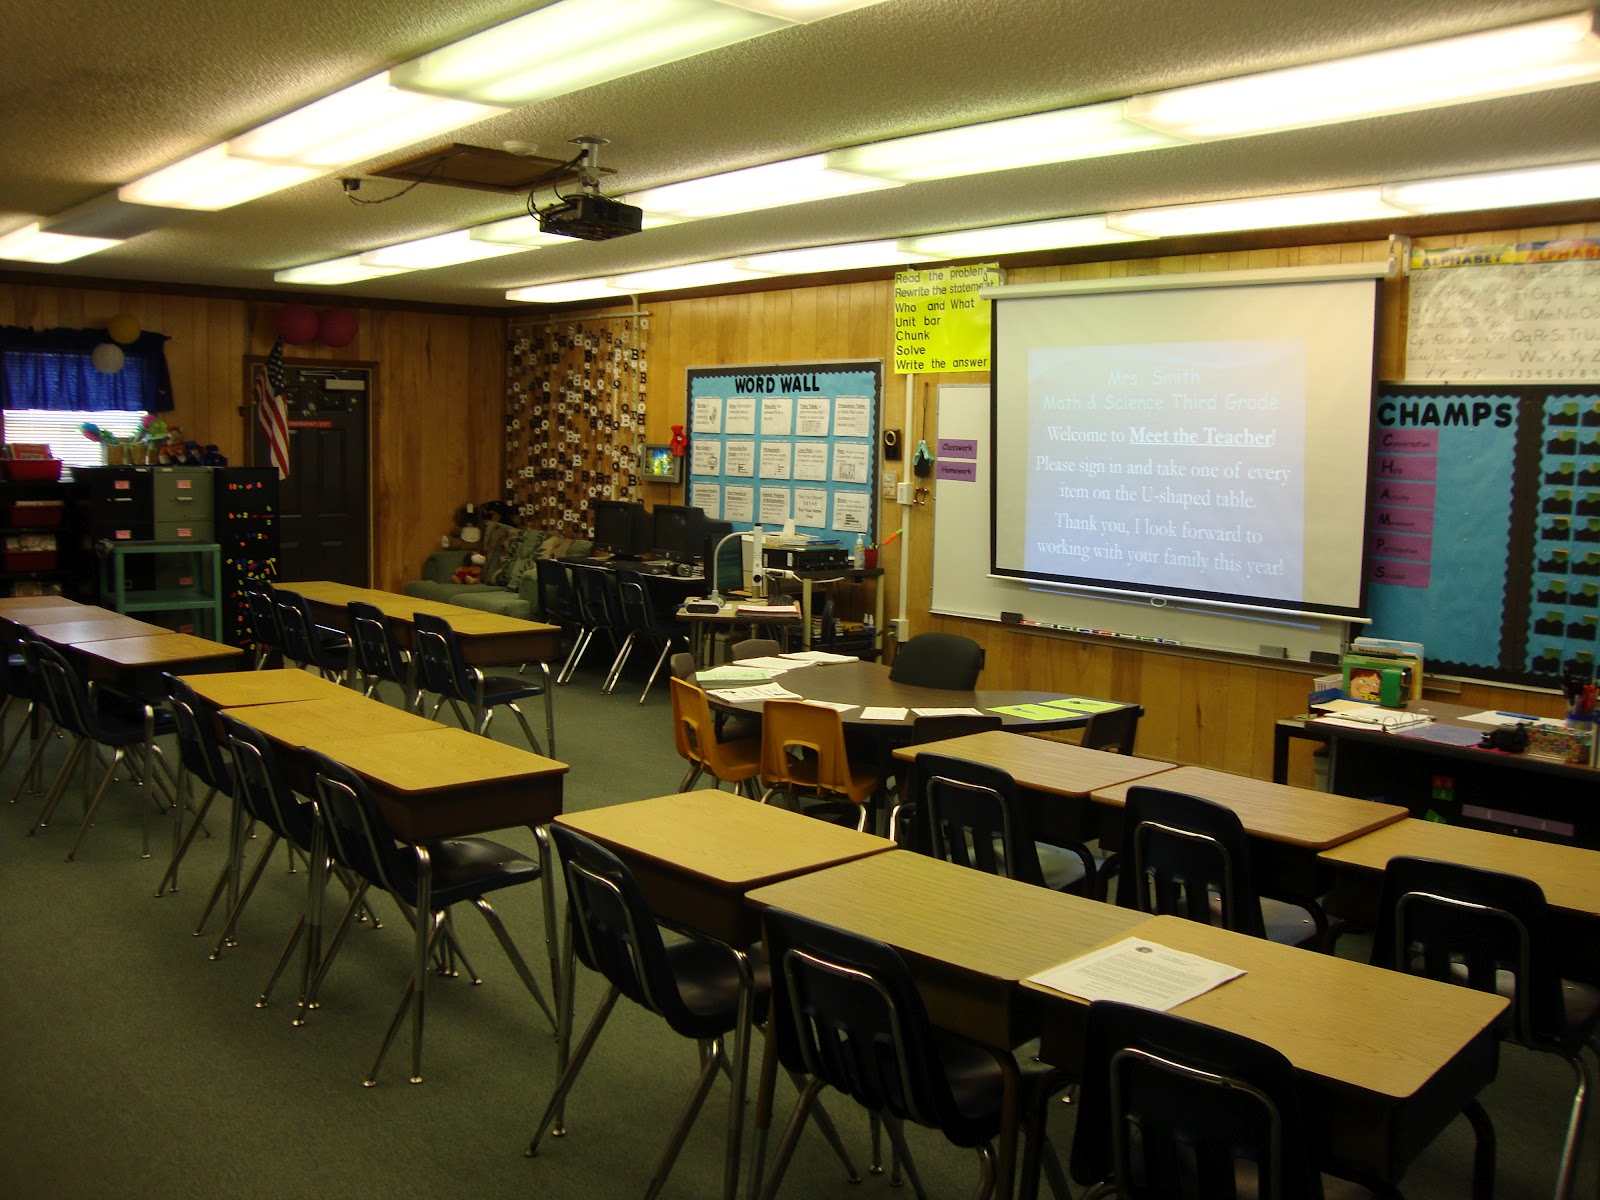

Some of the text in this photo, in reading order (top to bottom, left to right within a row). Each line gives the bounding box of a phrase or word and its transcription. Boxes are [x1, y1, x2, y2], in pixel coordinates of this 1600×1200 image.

[1421, 253, 1502, 267] ALPHABET
[895, 273, 921, 284] Read
[928, 271, 944, 281] the
[895, 286, 930, 298] Rewrite
[932, 285, 947, 296] the
[895, 298, 975, 313] Who and What
[895, 316, 941, 327] Unit bar
[895, 330, 931, 341] Chunk
[895, 345, 926, 356] Solve
[896, 358, 988, 370] Write the answer
[735, 375, 820, 394] WORD WALL
[1151, 368, 1201, 386] Smith
[1043, 392, 1280, 411] Math & Science Third Grade
[1376, 401, 1514, 428] CHAMPS
[1047, 426, 1277, 447] Welcome to Meet the Teacher!
[1382, 433, 1431, 448] Conversation
[942, 443, 973, 452] Classwork
[942, 466, 972, 475] Homework
[1035, 456, 1291, 486] Please sign in and take one of every
[1060, 482, 1257, 510] item on the U-shaped table.
[1054, 512, 1263, 545] Thank you, I look forward to
[1036, 541, 1284, 578] working with your family this year!
